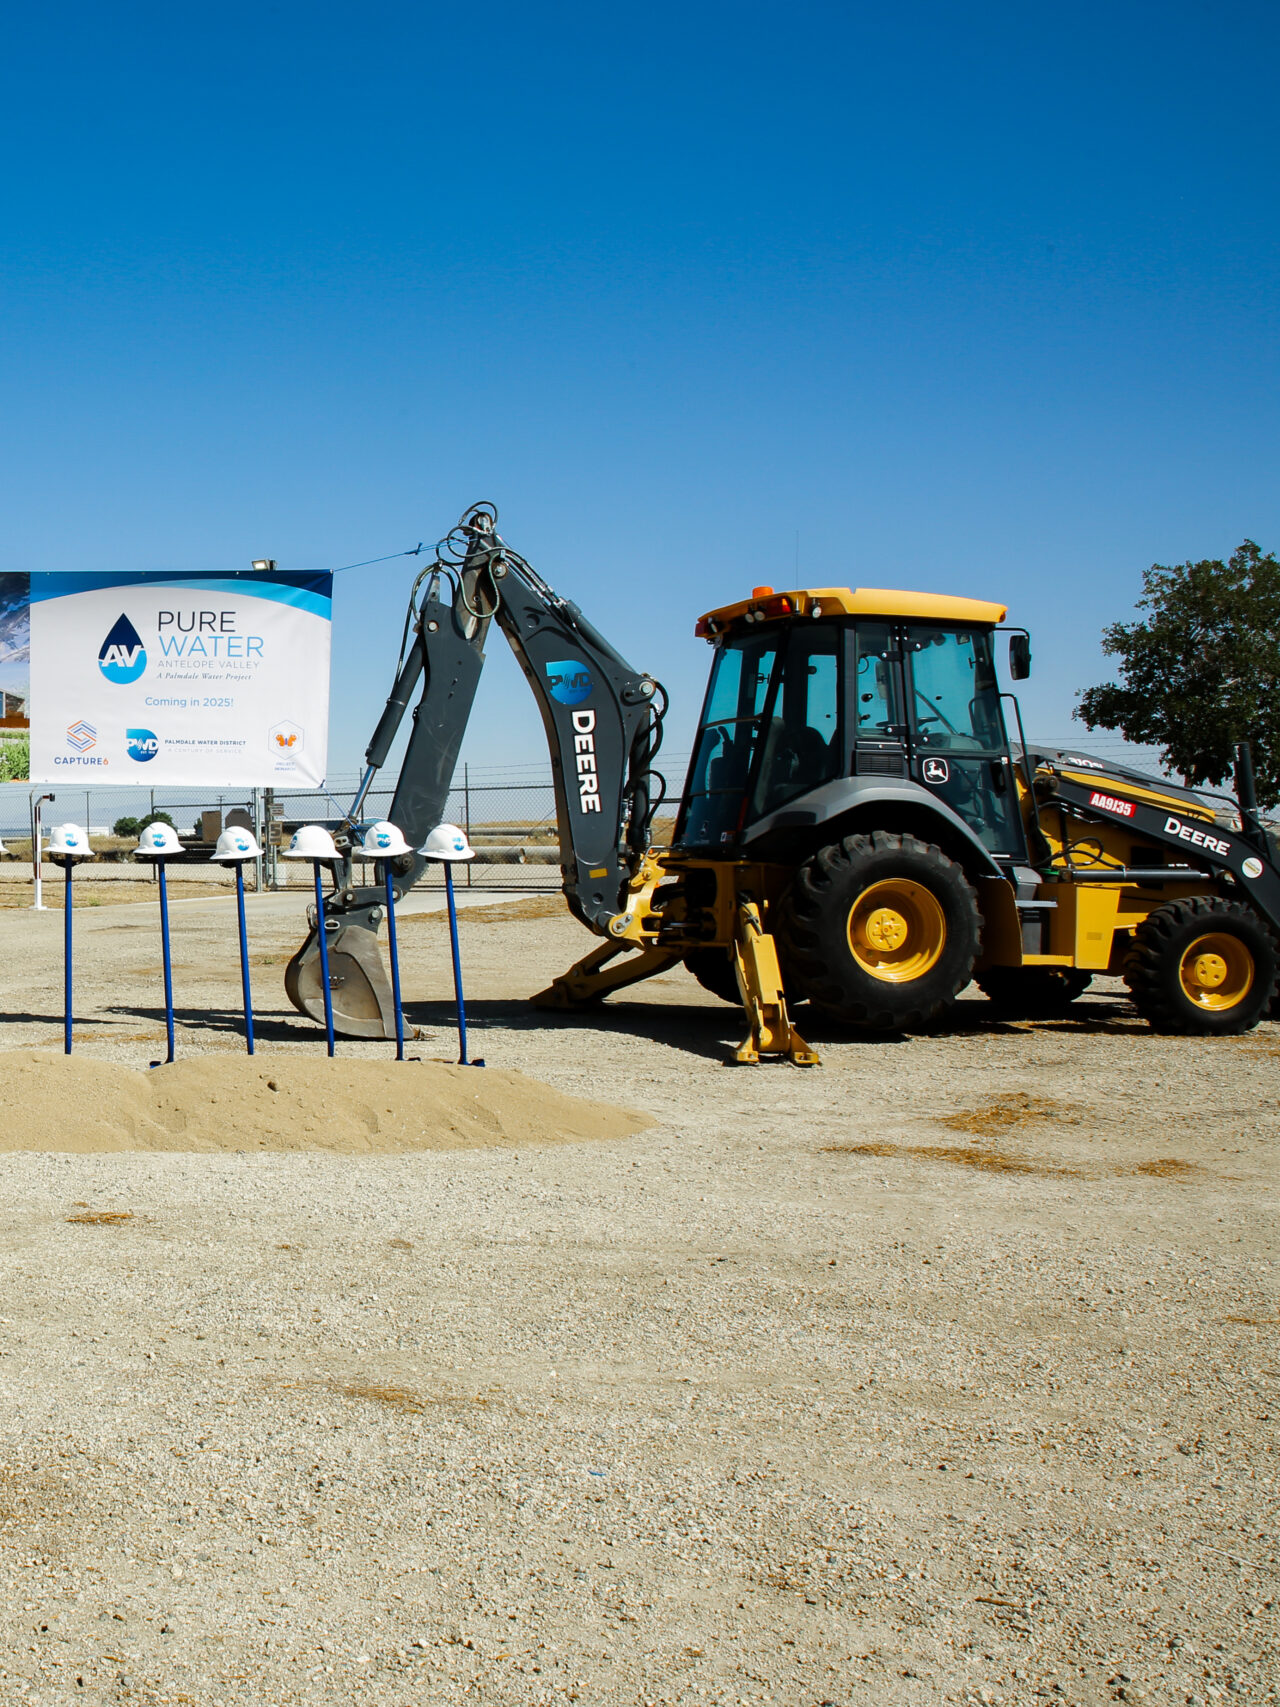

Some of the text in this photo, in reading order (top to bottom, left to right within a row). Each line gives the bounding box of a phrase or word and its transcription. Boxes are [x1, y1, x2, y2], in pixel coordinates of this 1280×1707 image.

[157, 611, 236, 633] PURE
[101, 644, 143, 668] AV
[158, 635, 265, 658] WATER
[157, 660, 260, 669] ANTELOPE VALLEY
[157, 672, 252, 682] A Palmdale Water Project
[145, 697, 234, 708] Coming in 2025!
[54, 756, 109, 766] CAPTURE6
[571, 709, 602, 814] DEERE
[1091, 793, 1133, 817] AA9J35
[1163, 816, 1231, 857] DEERE
